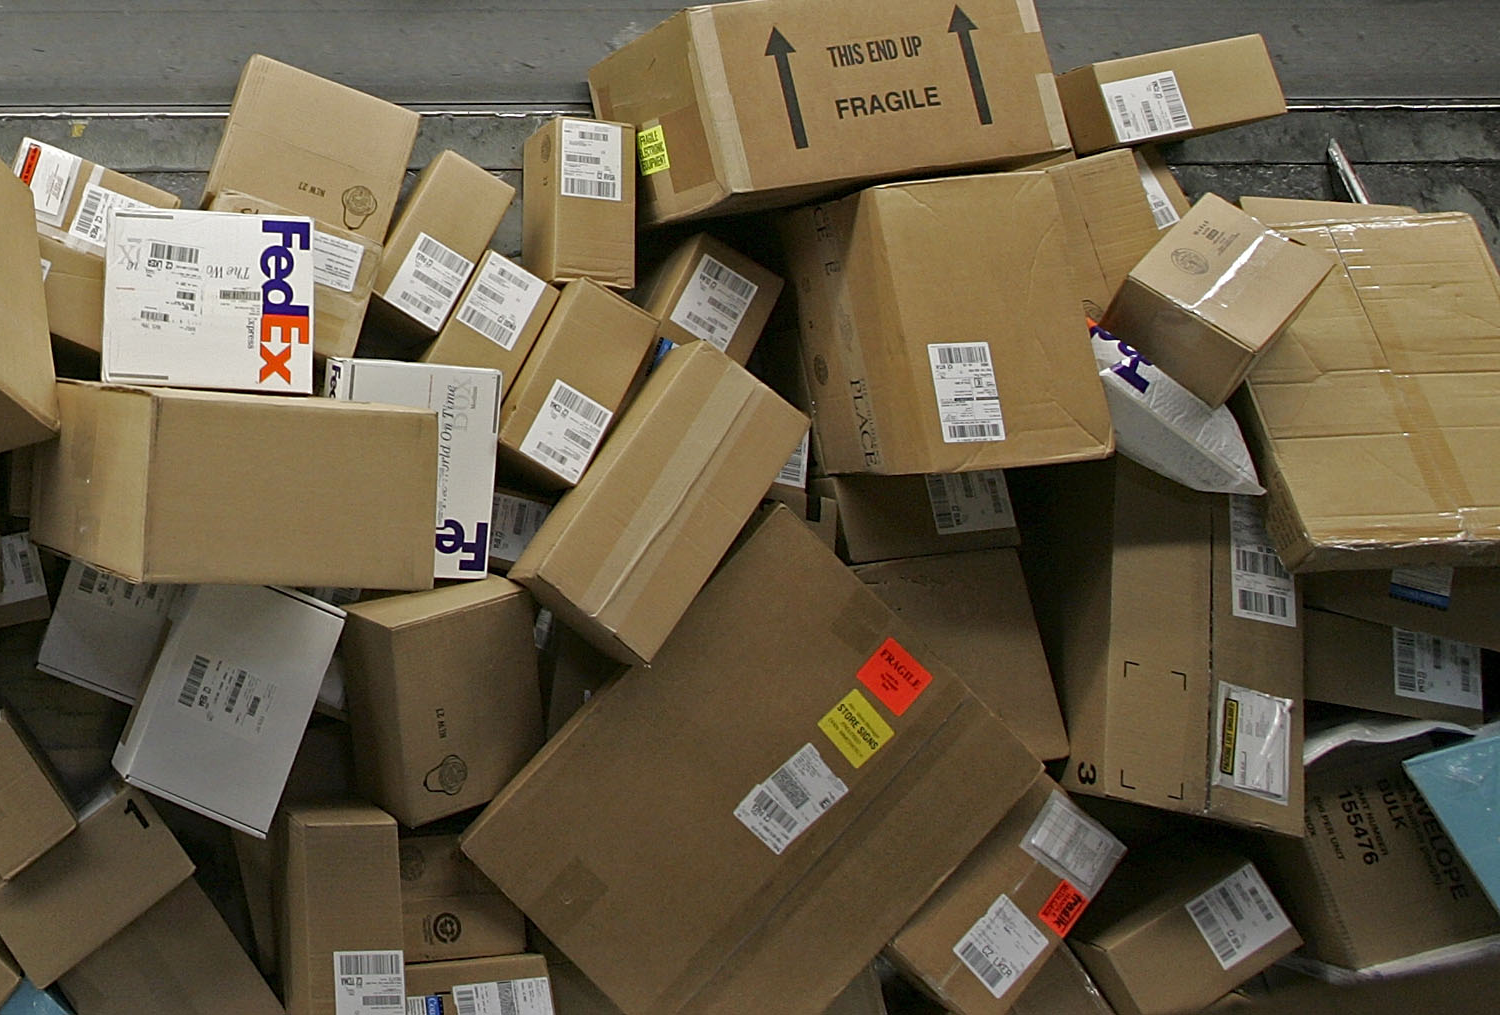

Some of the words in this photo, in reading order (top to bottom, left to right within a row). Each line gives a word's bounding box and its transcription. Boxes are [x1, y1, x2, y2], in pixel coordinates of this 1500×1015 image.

[827, 44, 864, 67] THIS
[866, 40, 898, 62] END
[901, 36, 922, 57] UP
[835, 87, 941, 119] FRAGILE
[259, 220, 311, 385] FedEx
[880, 649, 921, 690] FRAGILE
[836, 703, 858, 729] STORE
[857, 725, 879, 751] SIGNS
[1078, 762, 1097, 785] 3
[1339, 790, 1380, 866] 155476
